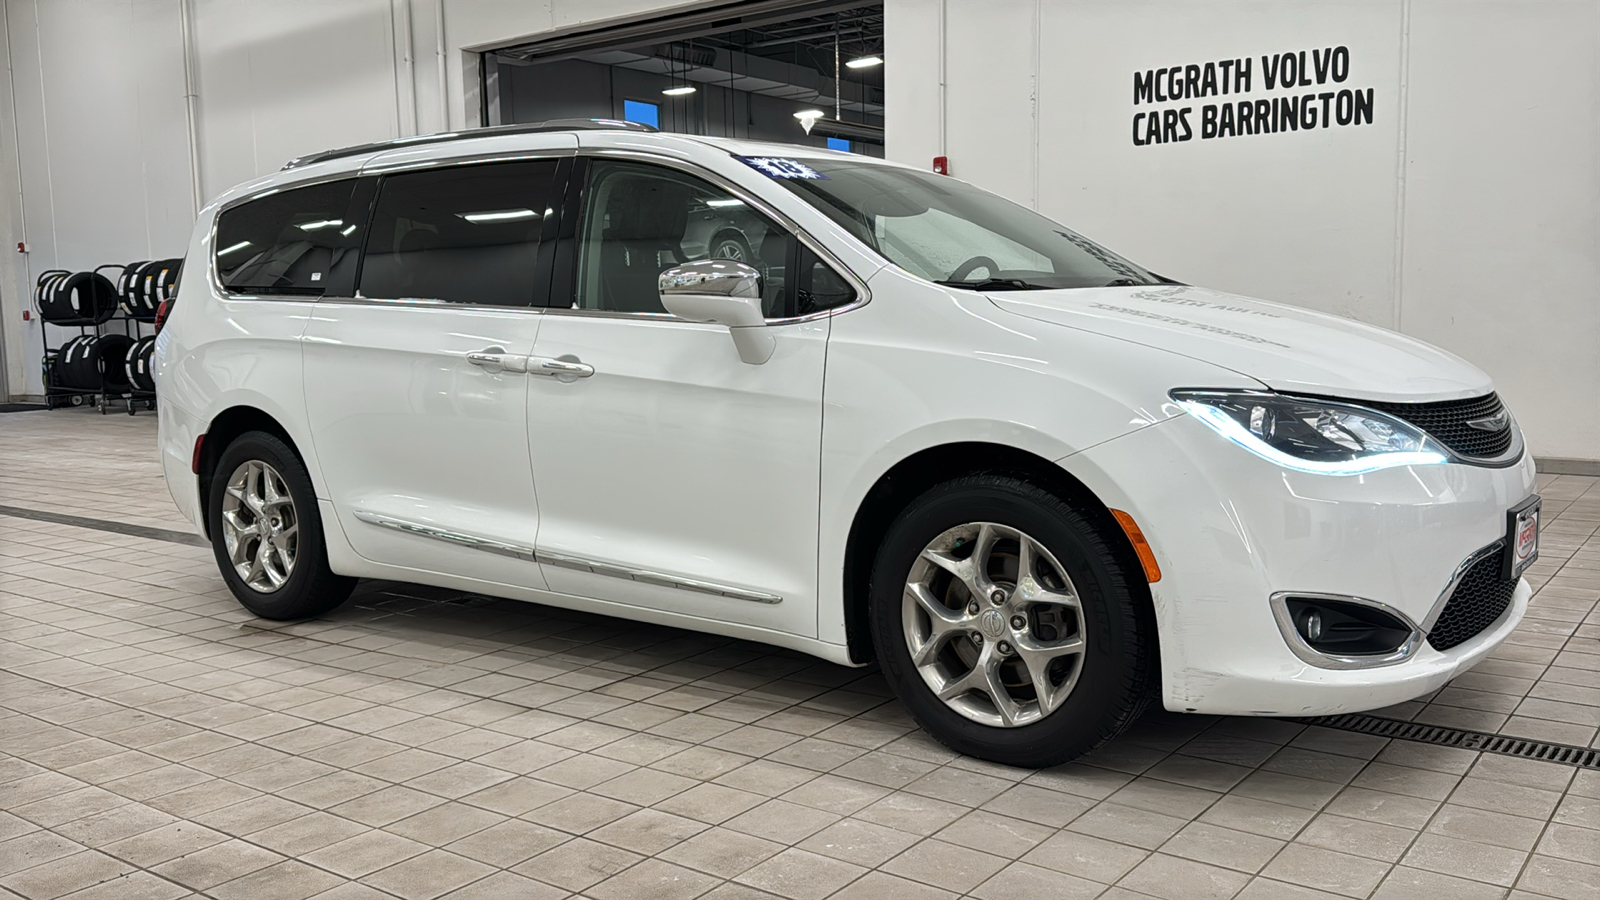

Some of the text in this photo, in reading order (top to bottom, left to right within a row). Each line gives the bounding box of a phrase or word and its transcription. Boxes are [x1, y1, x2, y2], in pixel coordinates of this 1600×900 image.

[1134, 46, 1349, 105] MCGRATH VOLVO
[1133, 88, 1373, 146] CARS BARRINGTON
[767, 161, 804, 174] 18
